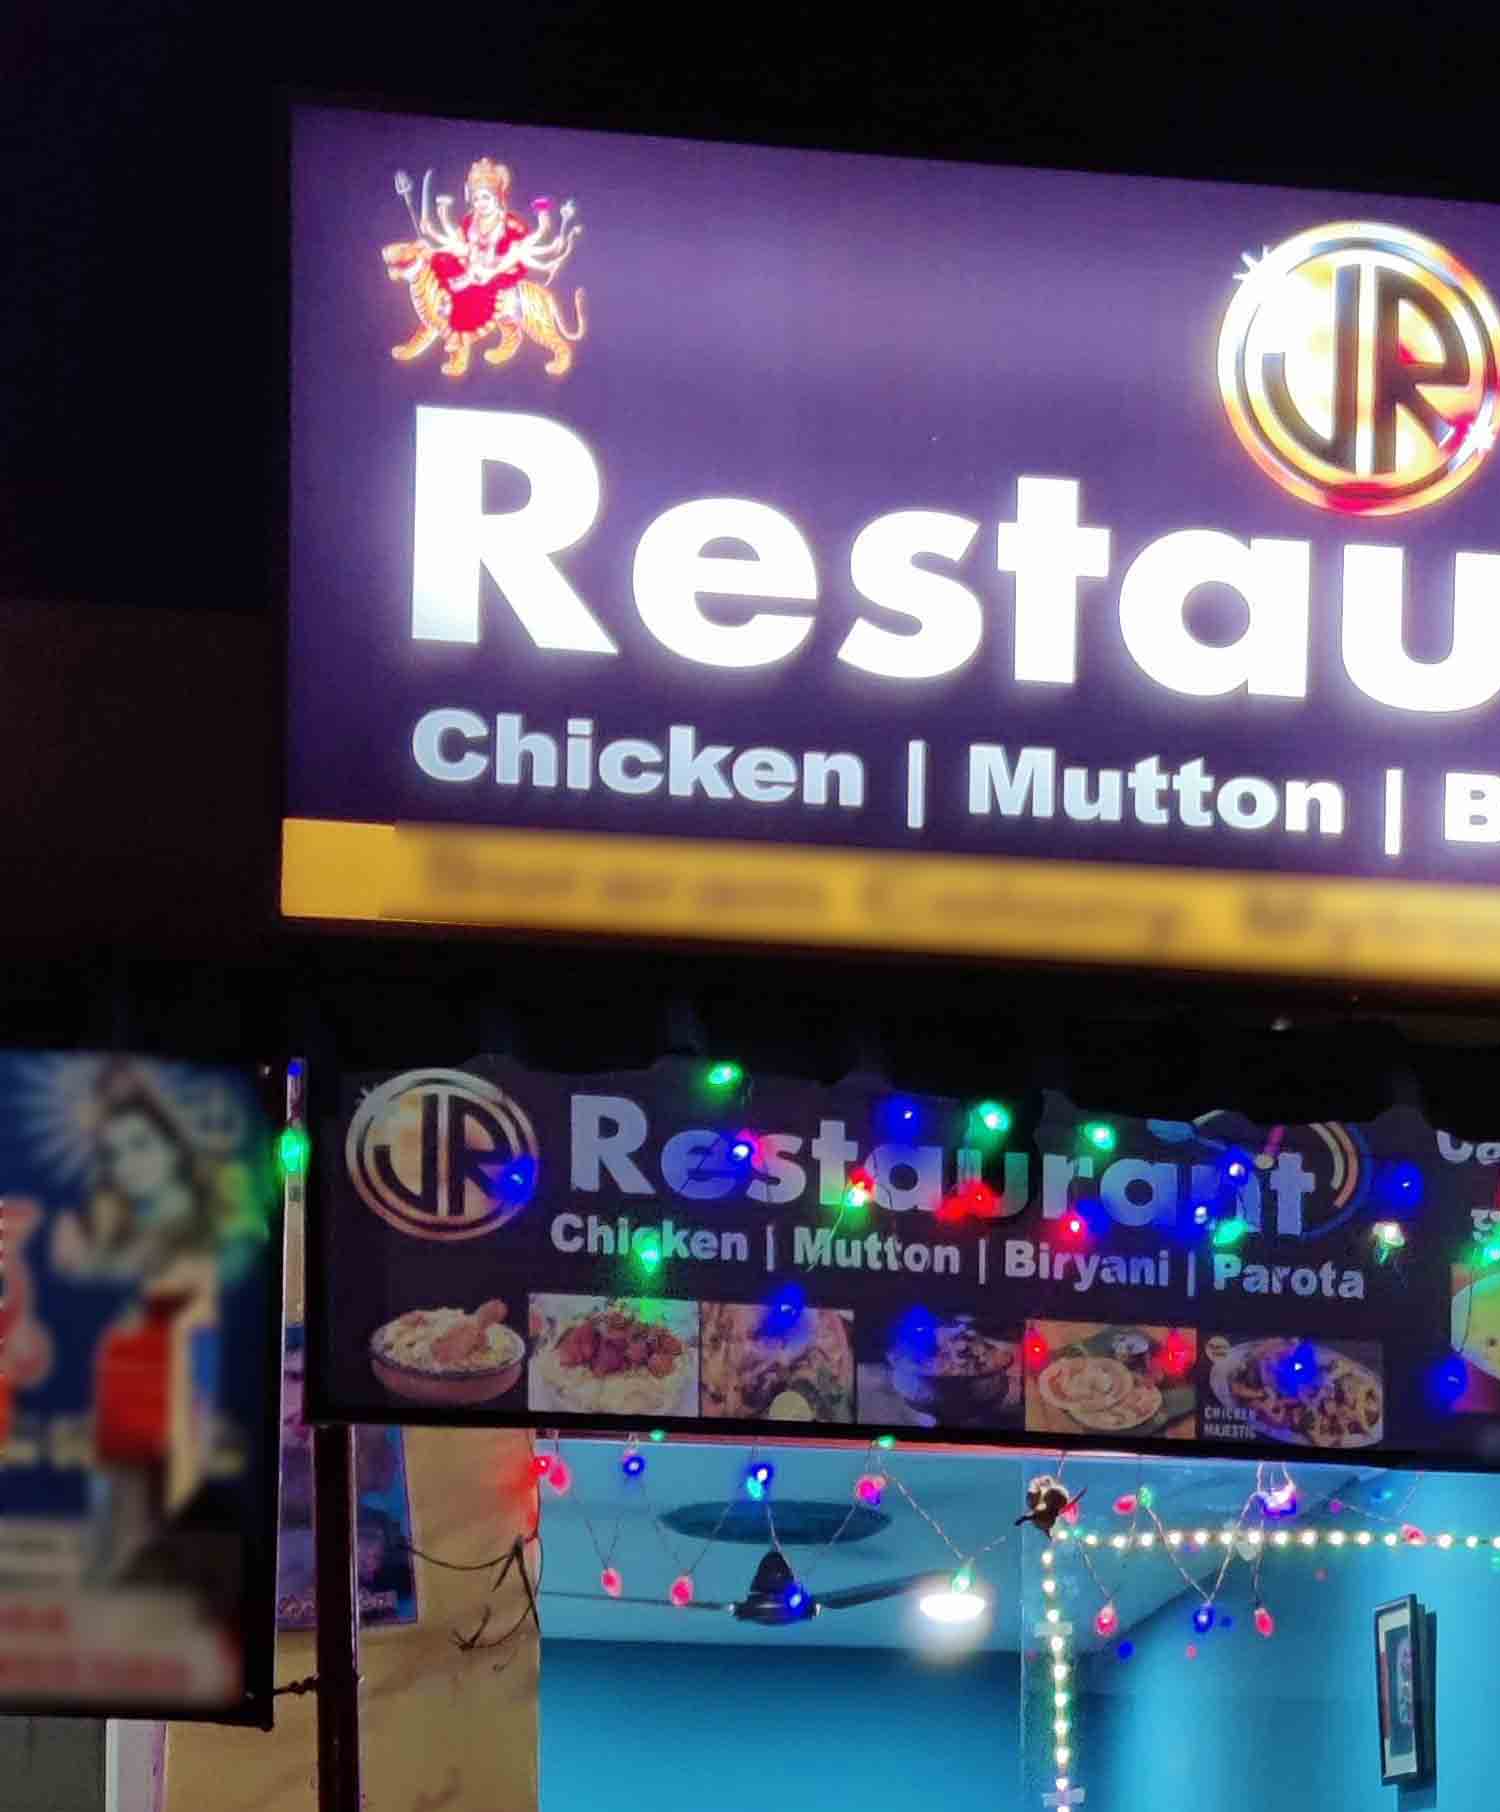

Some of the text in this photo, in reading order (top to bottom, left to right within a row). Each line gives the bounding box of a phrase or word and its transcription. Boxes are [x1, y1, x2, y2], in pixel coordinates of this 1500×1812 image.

[412, 708, 864, 807] Chicken
[968, 743, 1346, 838] Mutton
[570, 1093, 1315, 1236] Restaurant
[551, 1213, 749, 1263] Chicken
[793, 1226, 961, 1274] Mutton
[1004, 1239, 1169, 1292] Biryani
[1213, 1253, 1366, 1300] Parota
